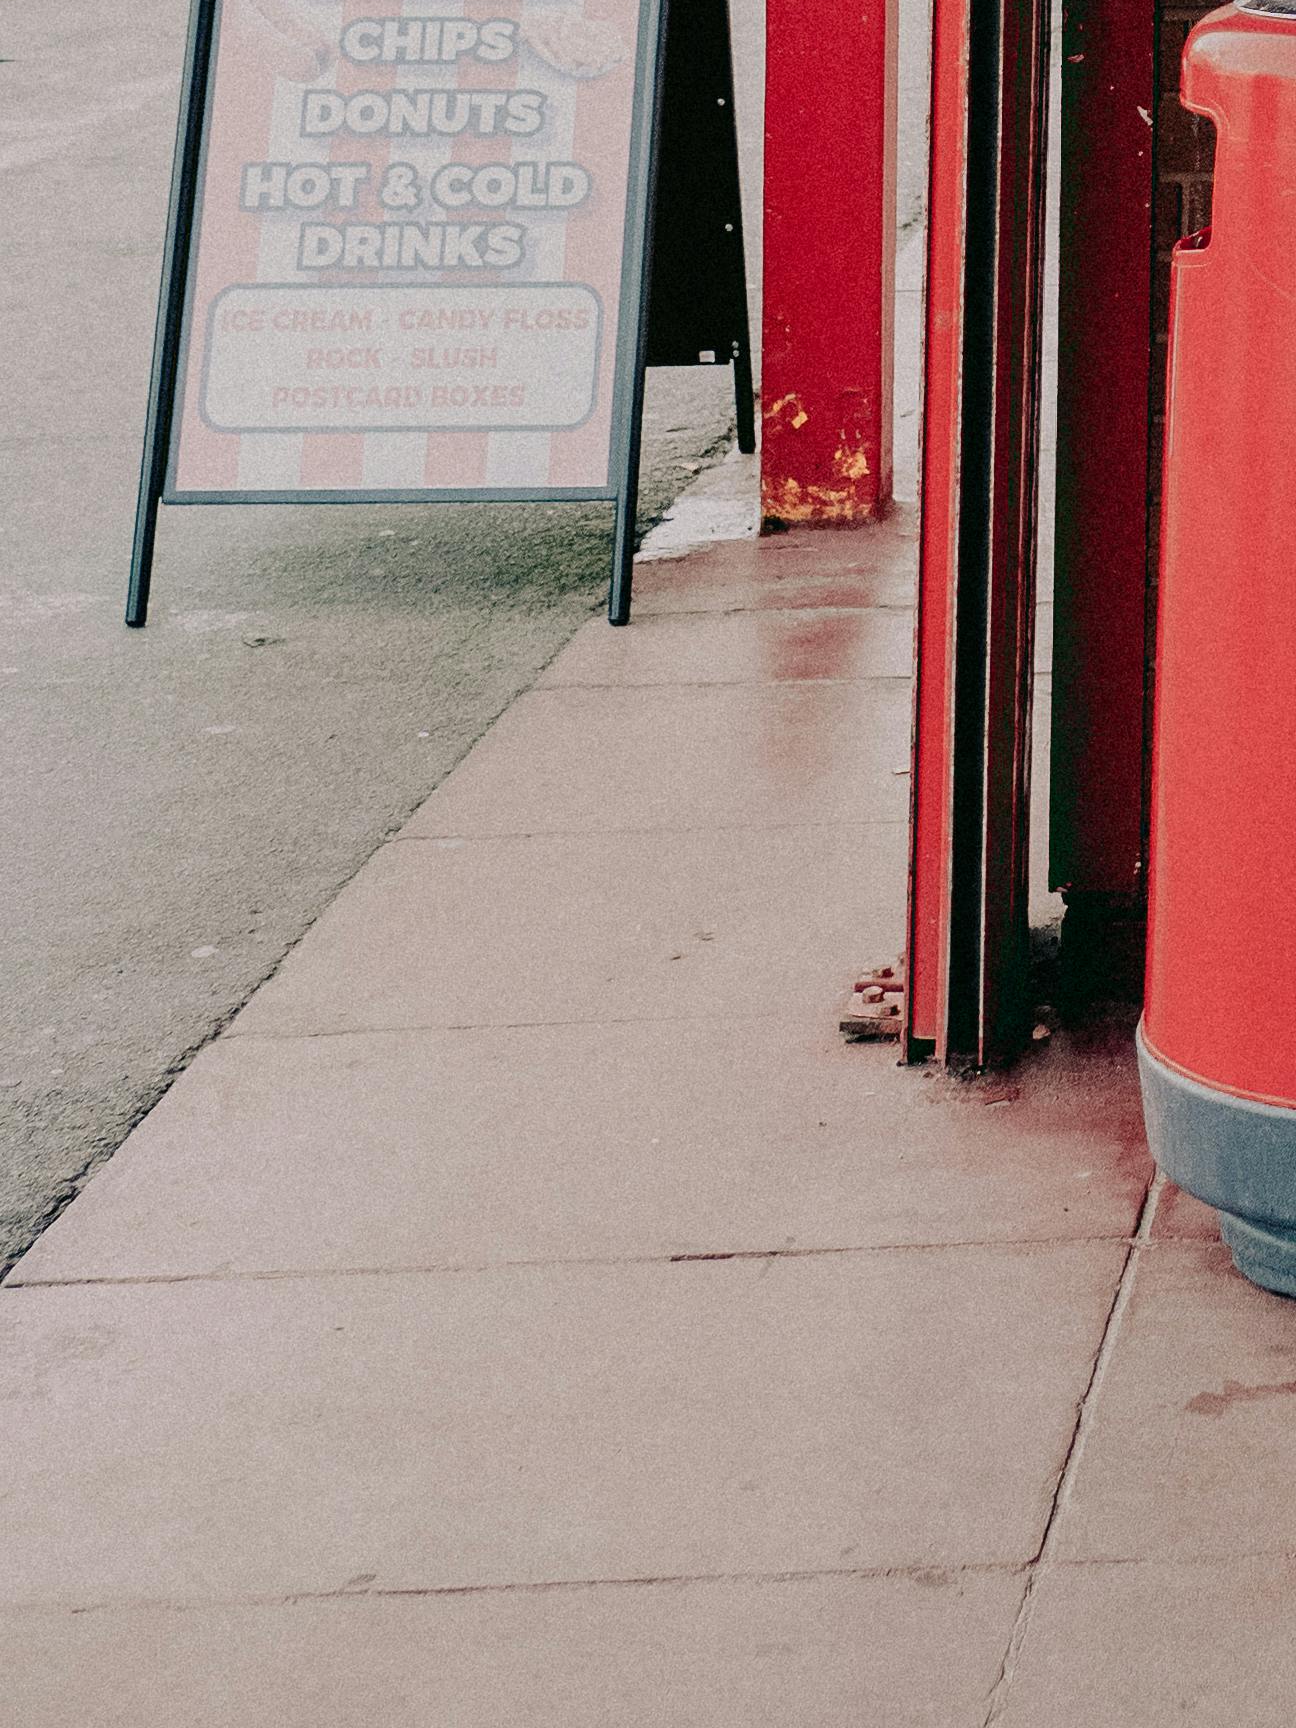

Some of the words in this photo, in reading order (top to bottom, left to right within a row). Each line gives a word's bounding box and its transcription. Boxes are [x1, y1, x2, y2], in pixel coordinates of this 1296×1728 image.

[339, 19, 518, 65] CHIPS
[301, 89, 546, 138] DONUTS
[241, 164, 378, 211] HOT
[381, 164, 424, 211] &
[430, 162, 592, 210] COLD
[298, 223, 526, 271] DRINKS
[221, 309, 266, 333] ICE
[271, 308, 374, 333] CREAM
[399, 308, 497, 331] CANDY
[502, 308, 591, 331] FLOSS
[306, 348, 382, 370] ROCK
[409, 347, 499, 370] SLUSH
[270, 385, 424, 409] POSTCARD
[430, 384, 526, 408] BOXES
